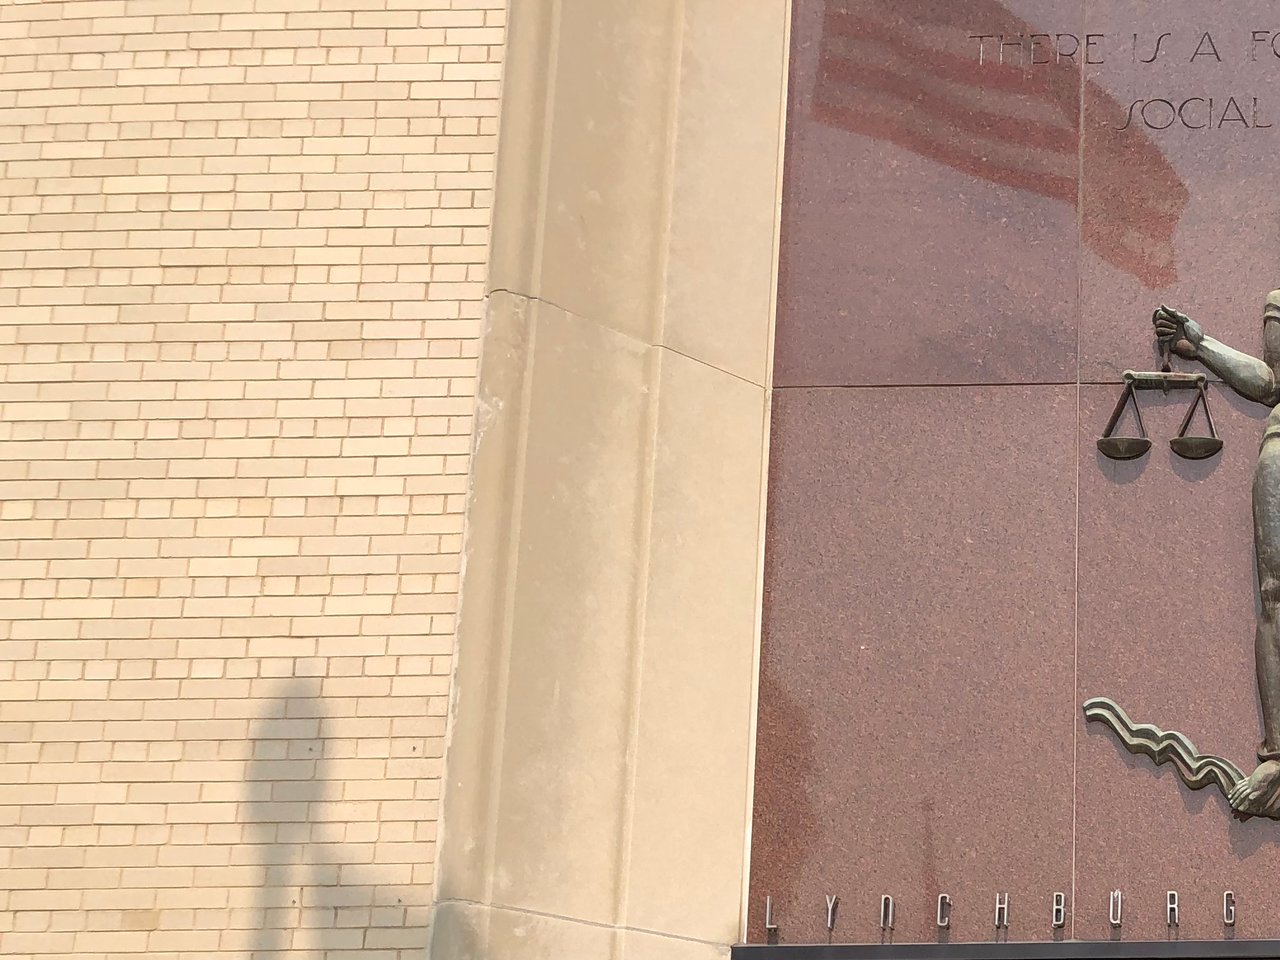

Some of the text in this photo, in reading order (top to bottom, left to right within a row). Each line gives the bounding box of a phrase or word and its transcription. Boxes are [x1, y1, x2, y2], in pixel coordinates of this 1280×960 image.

[968, 33, 1105, 66] THERE
[1131, 32, 1171, 64] IS
[1189, 30, 1222, 63] A
[1116, 96, 1233, 131] SOCIAL
[765, 889, 1236, 931] LYNCHBURG
